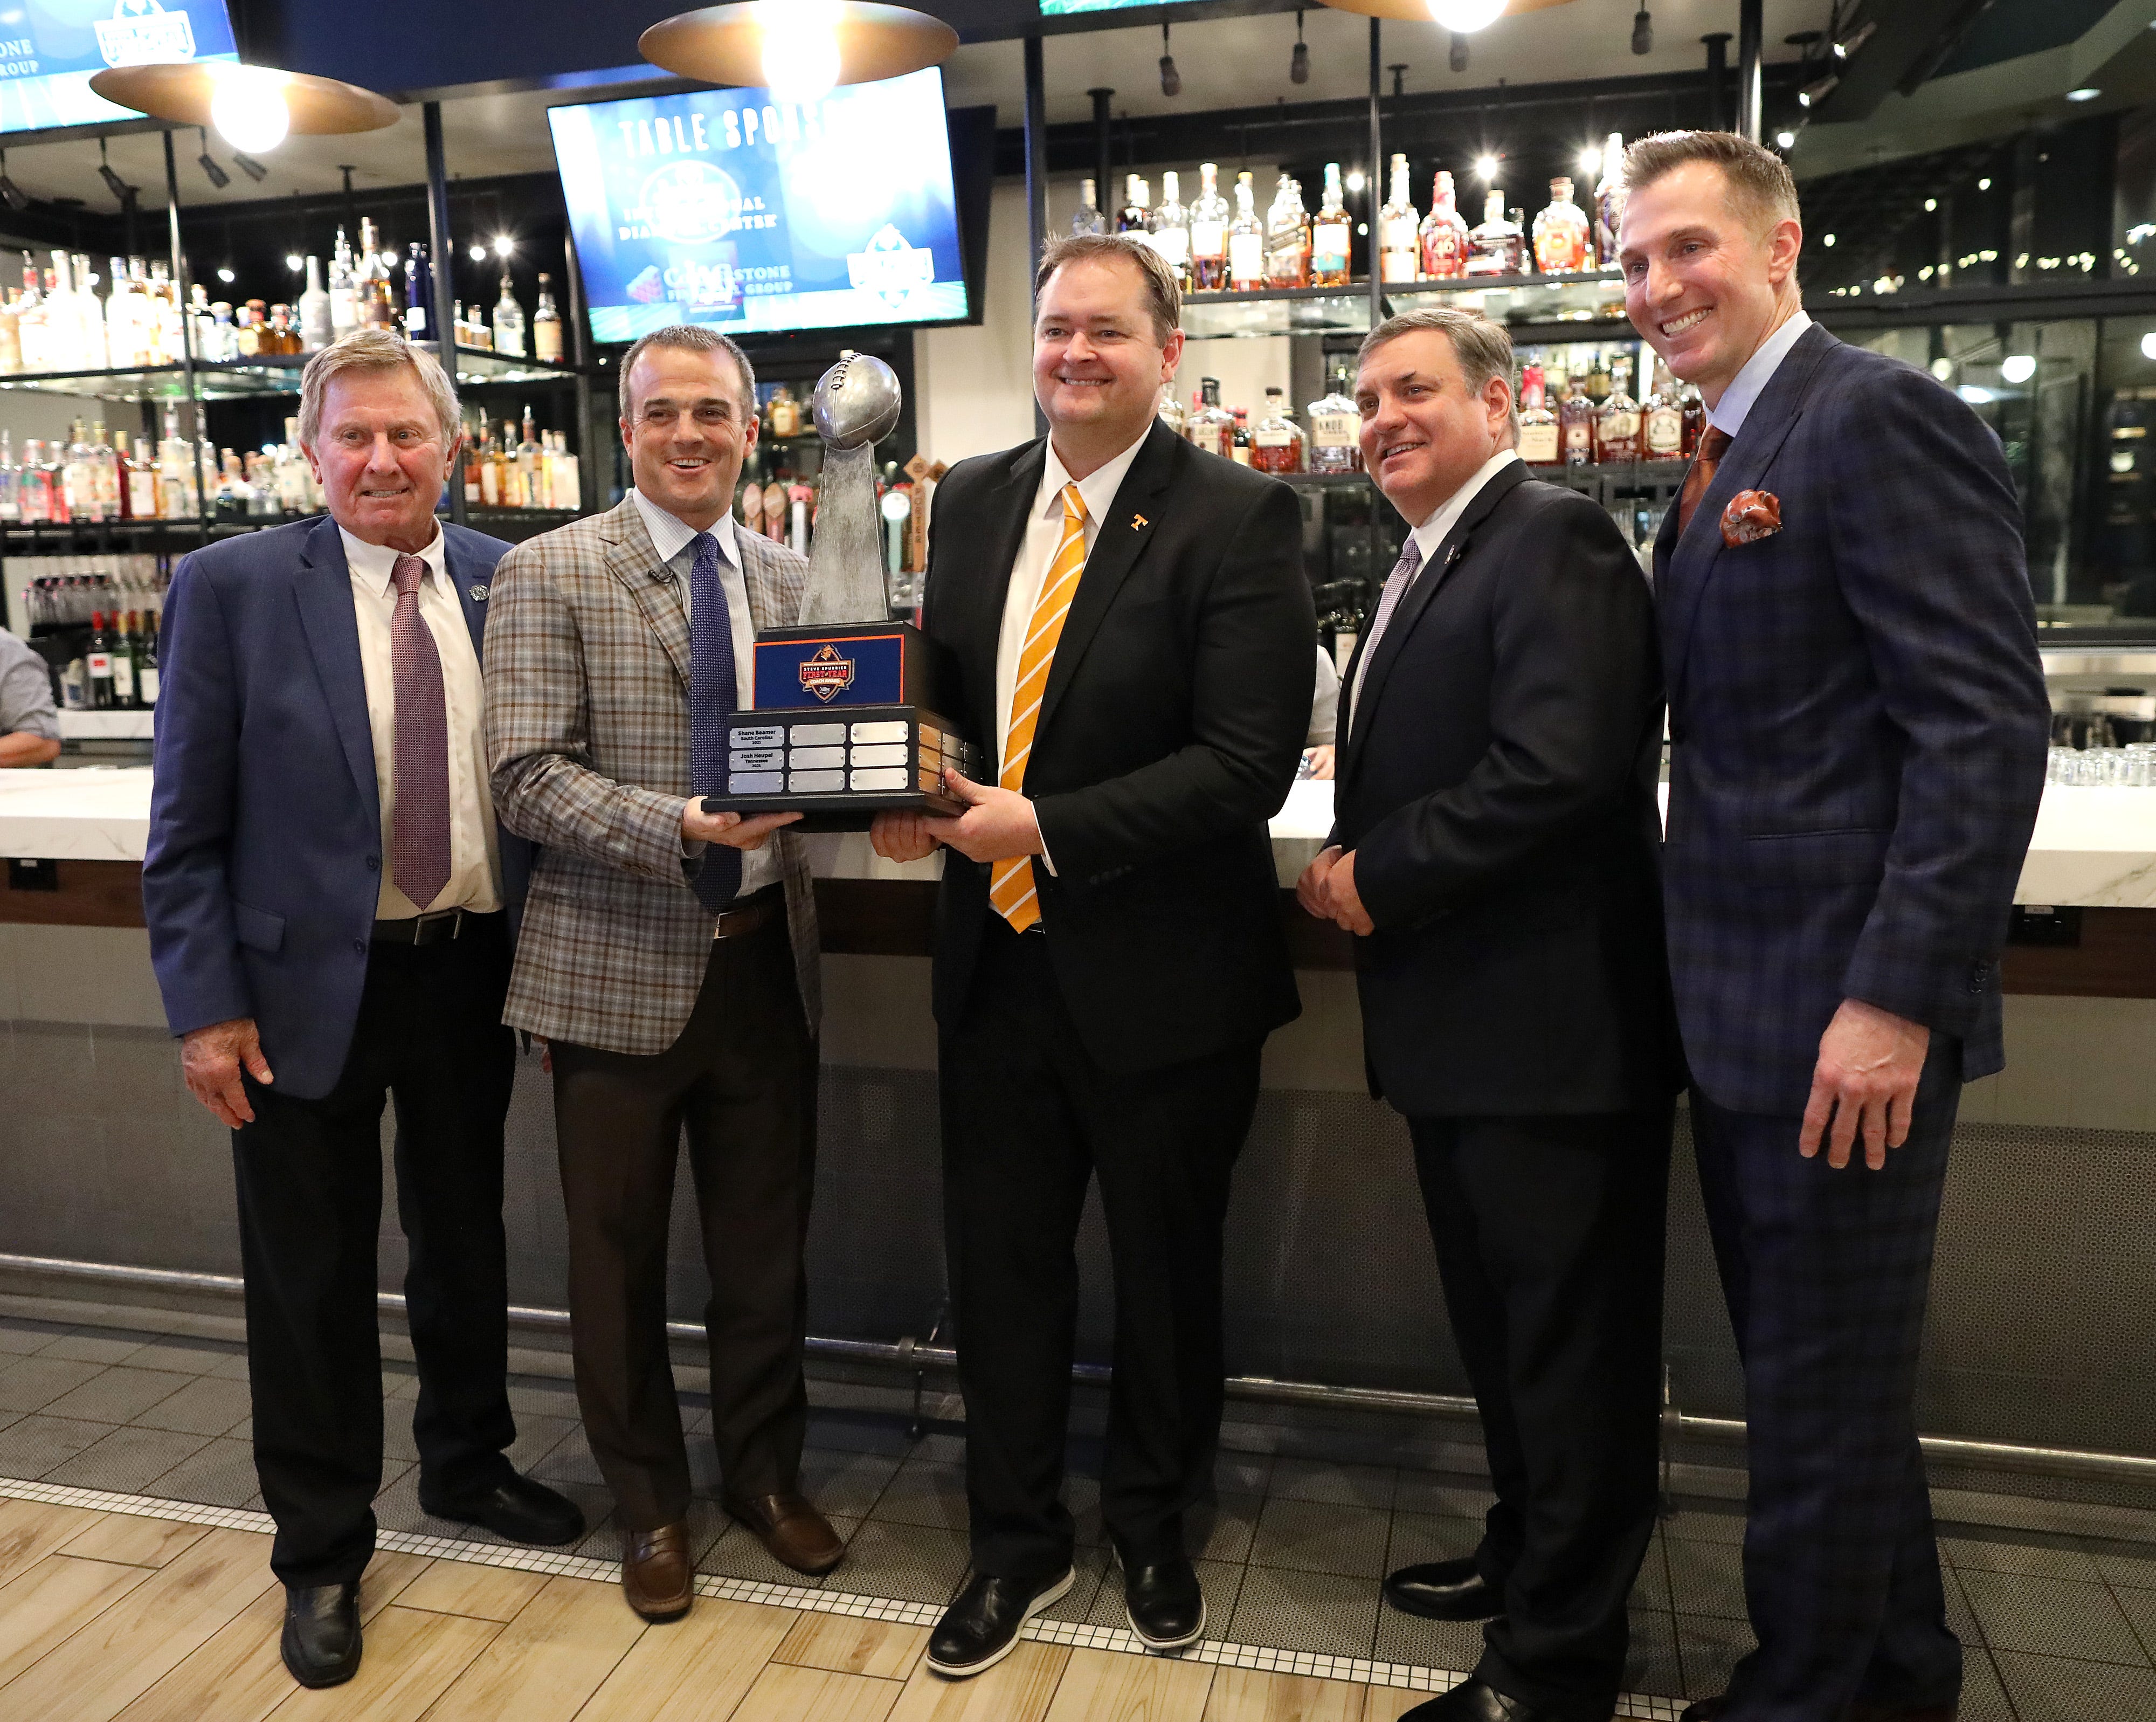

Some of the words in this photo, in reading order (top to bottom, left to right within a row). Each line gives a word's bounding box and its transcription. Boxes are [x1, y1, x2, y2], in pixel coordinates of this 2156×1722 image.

[618, 113, 709, 159] TABLE
[745, 281, 793, 295] GROUP
[1131, 514, 1149, 531] T
[803, 670, 825, 679] FIRST
[827, 670, 847, 678] YEAR
